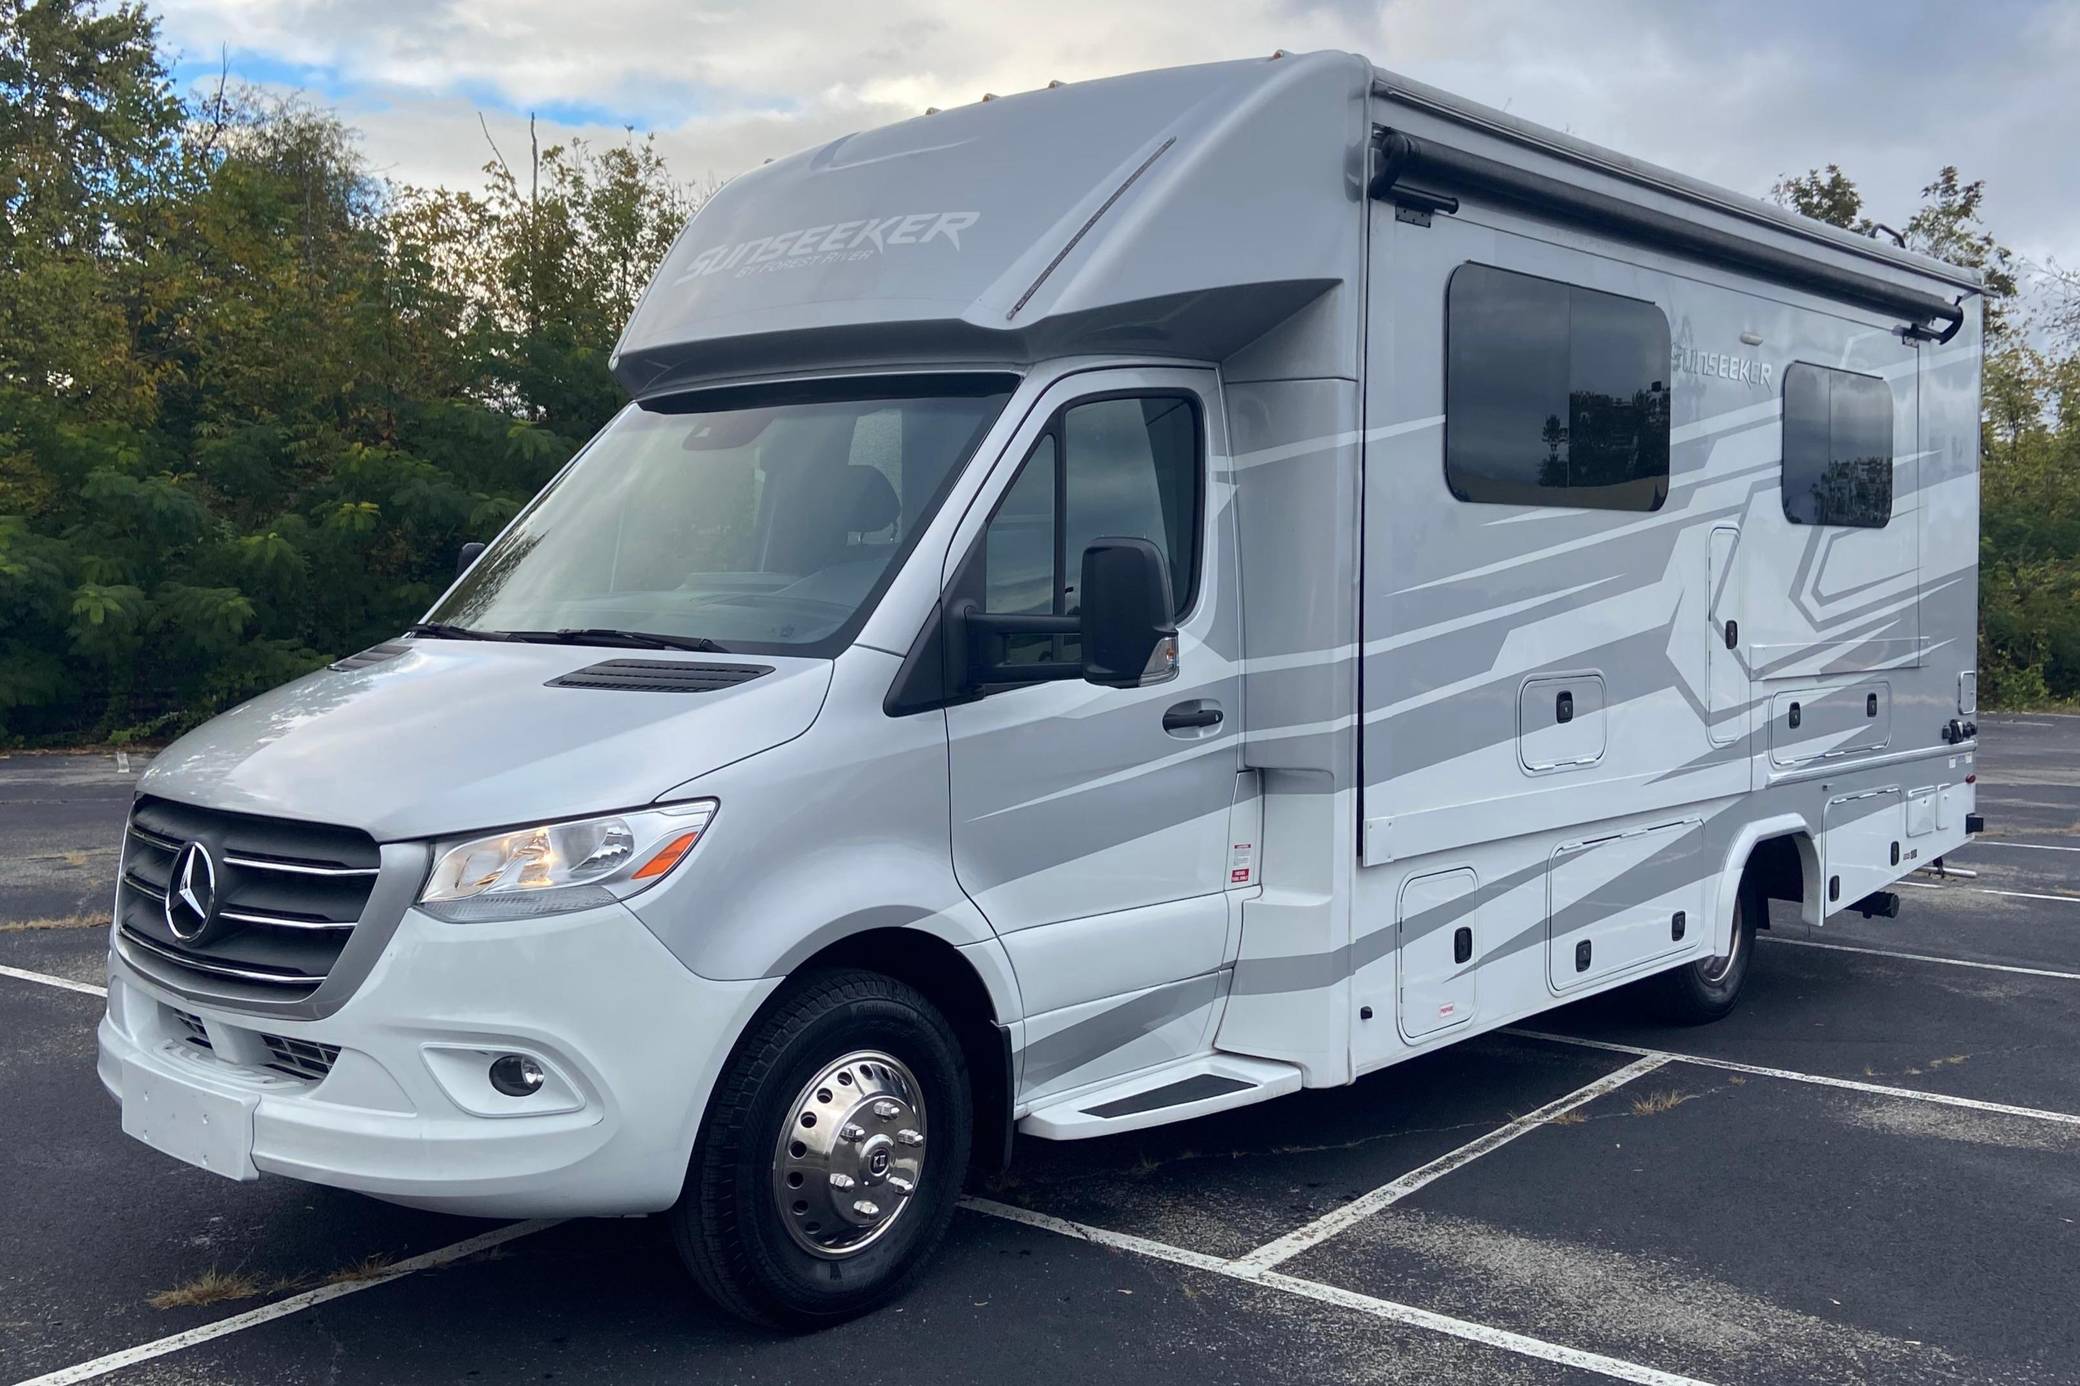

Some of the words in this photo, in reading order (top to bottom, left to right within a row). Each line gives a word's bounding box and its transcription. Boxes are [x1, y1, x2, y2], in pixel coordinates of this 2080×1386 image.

[673, 210, 981, 287] SUNSEEKER
[821, 249, 875, 265] RIVER
[1671, 343, 1773, 393] SUNSEEKER
